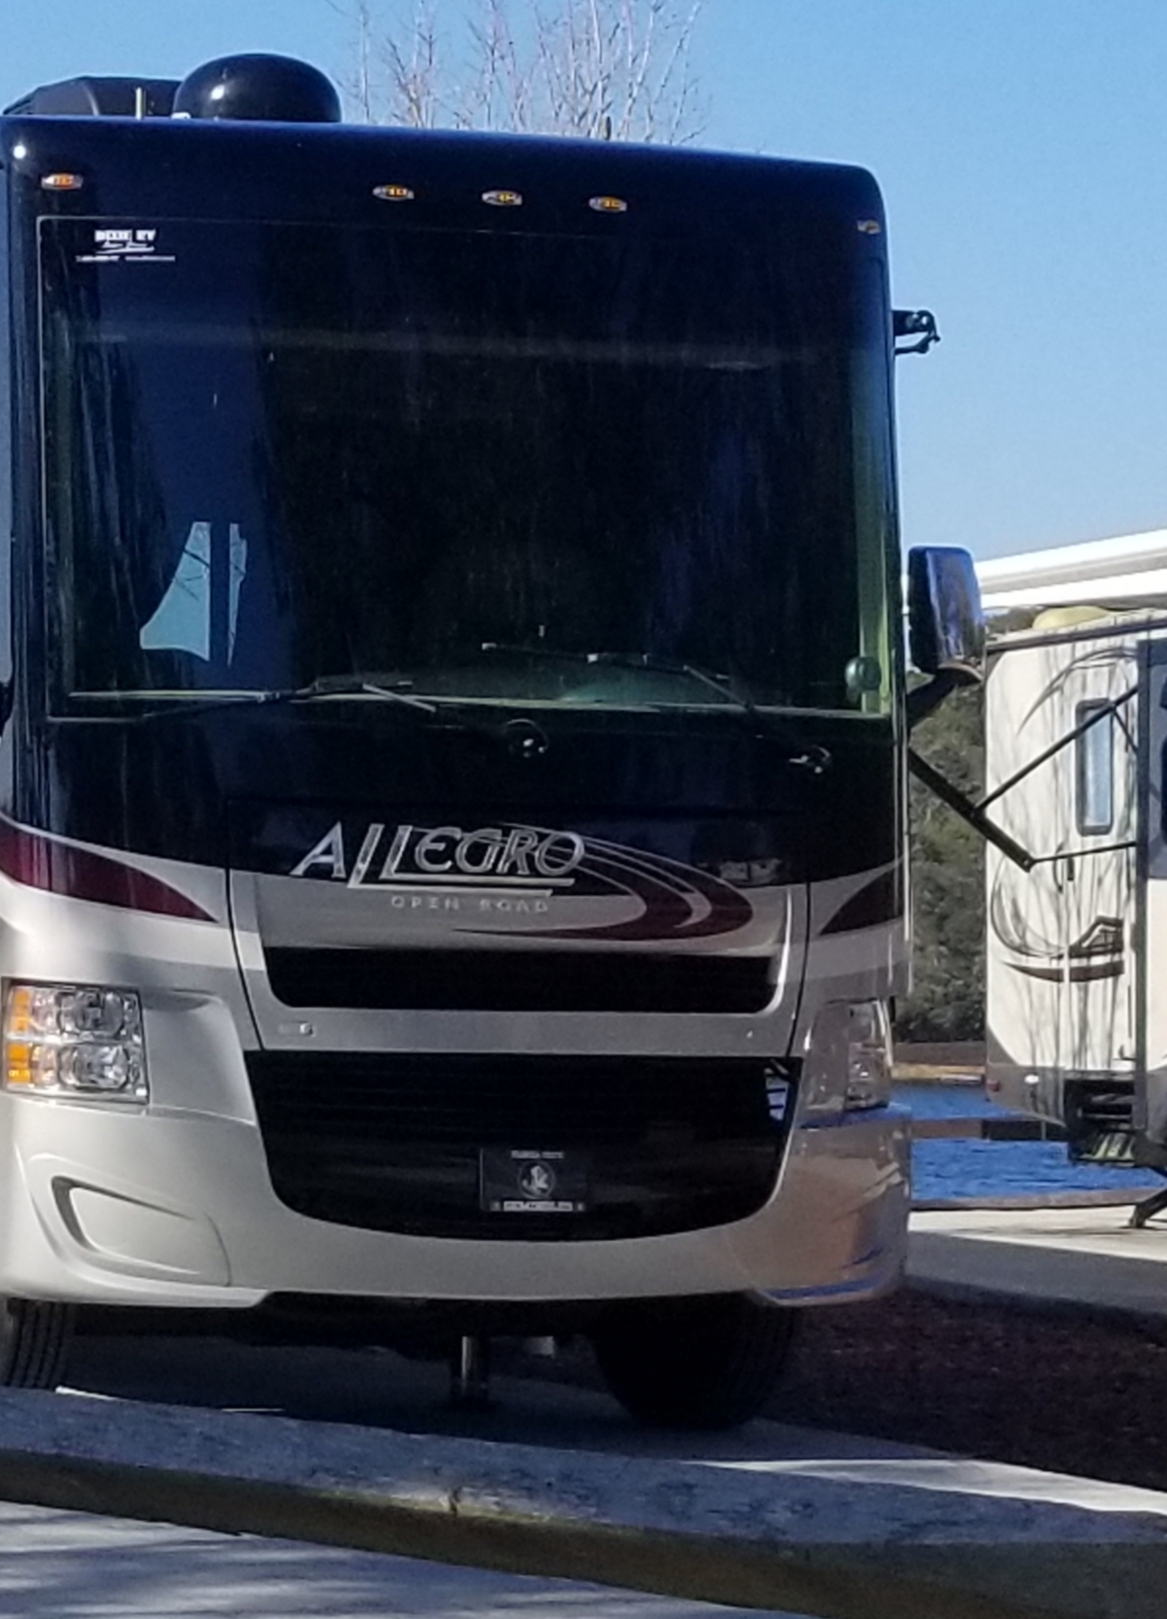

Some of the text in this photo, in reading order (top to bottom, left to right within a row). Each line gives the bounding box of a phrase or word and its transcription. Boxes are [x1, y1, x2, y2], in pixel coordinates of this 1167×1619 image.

[289, 822, 585, 896] ALLEGRO
[391, 895, 548, 913] OPEN ROAD
